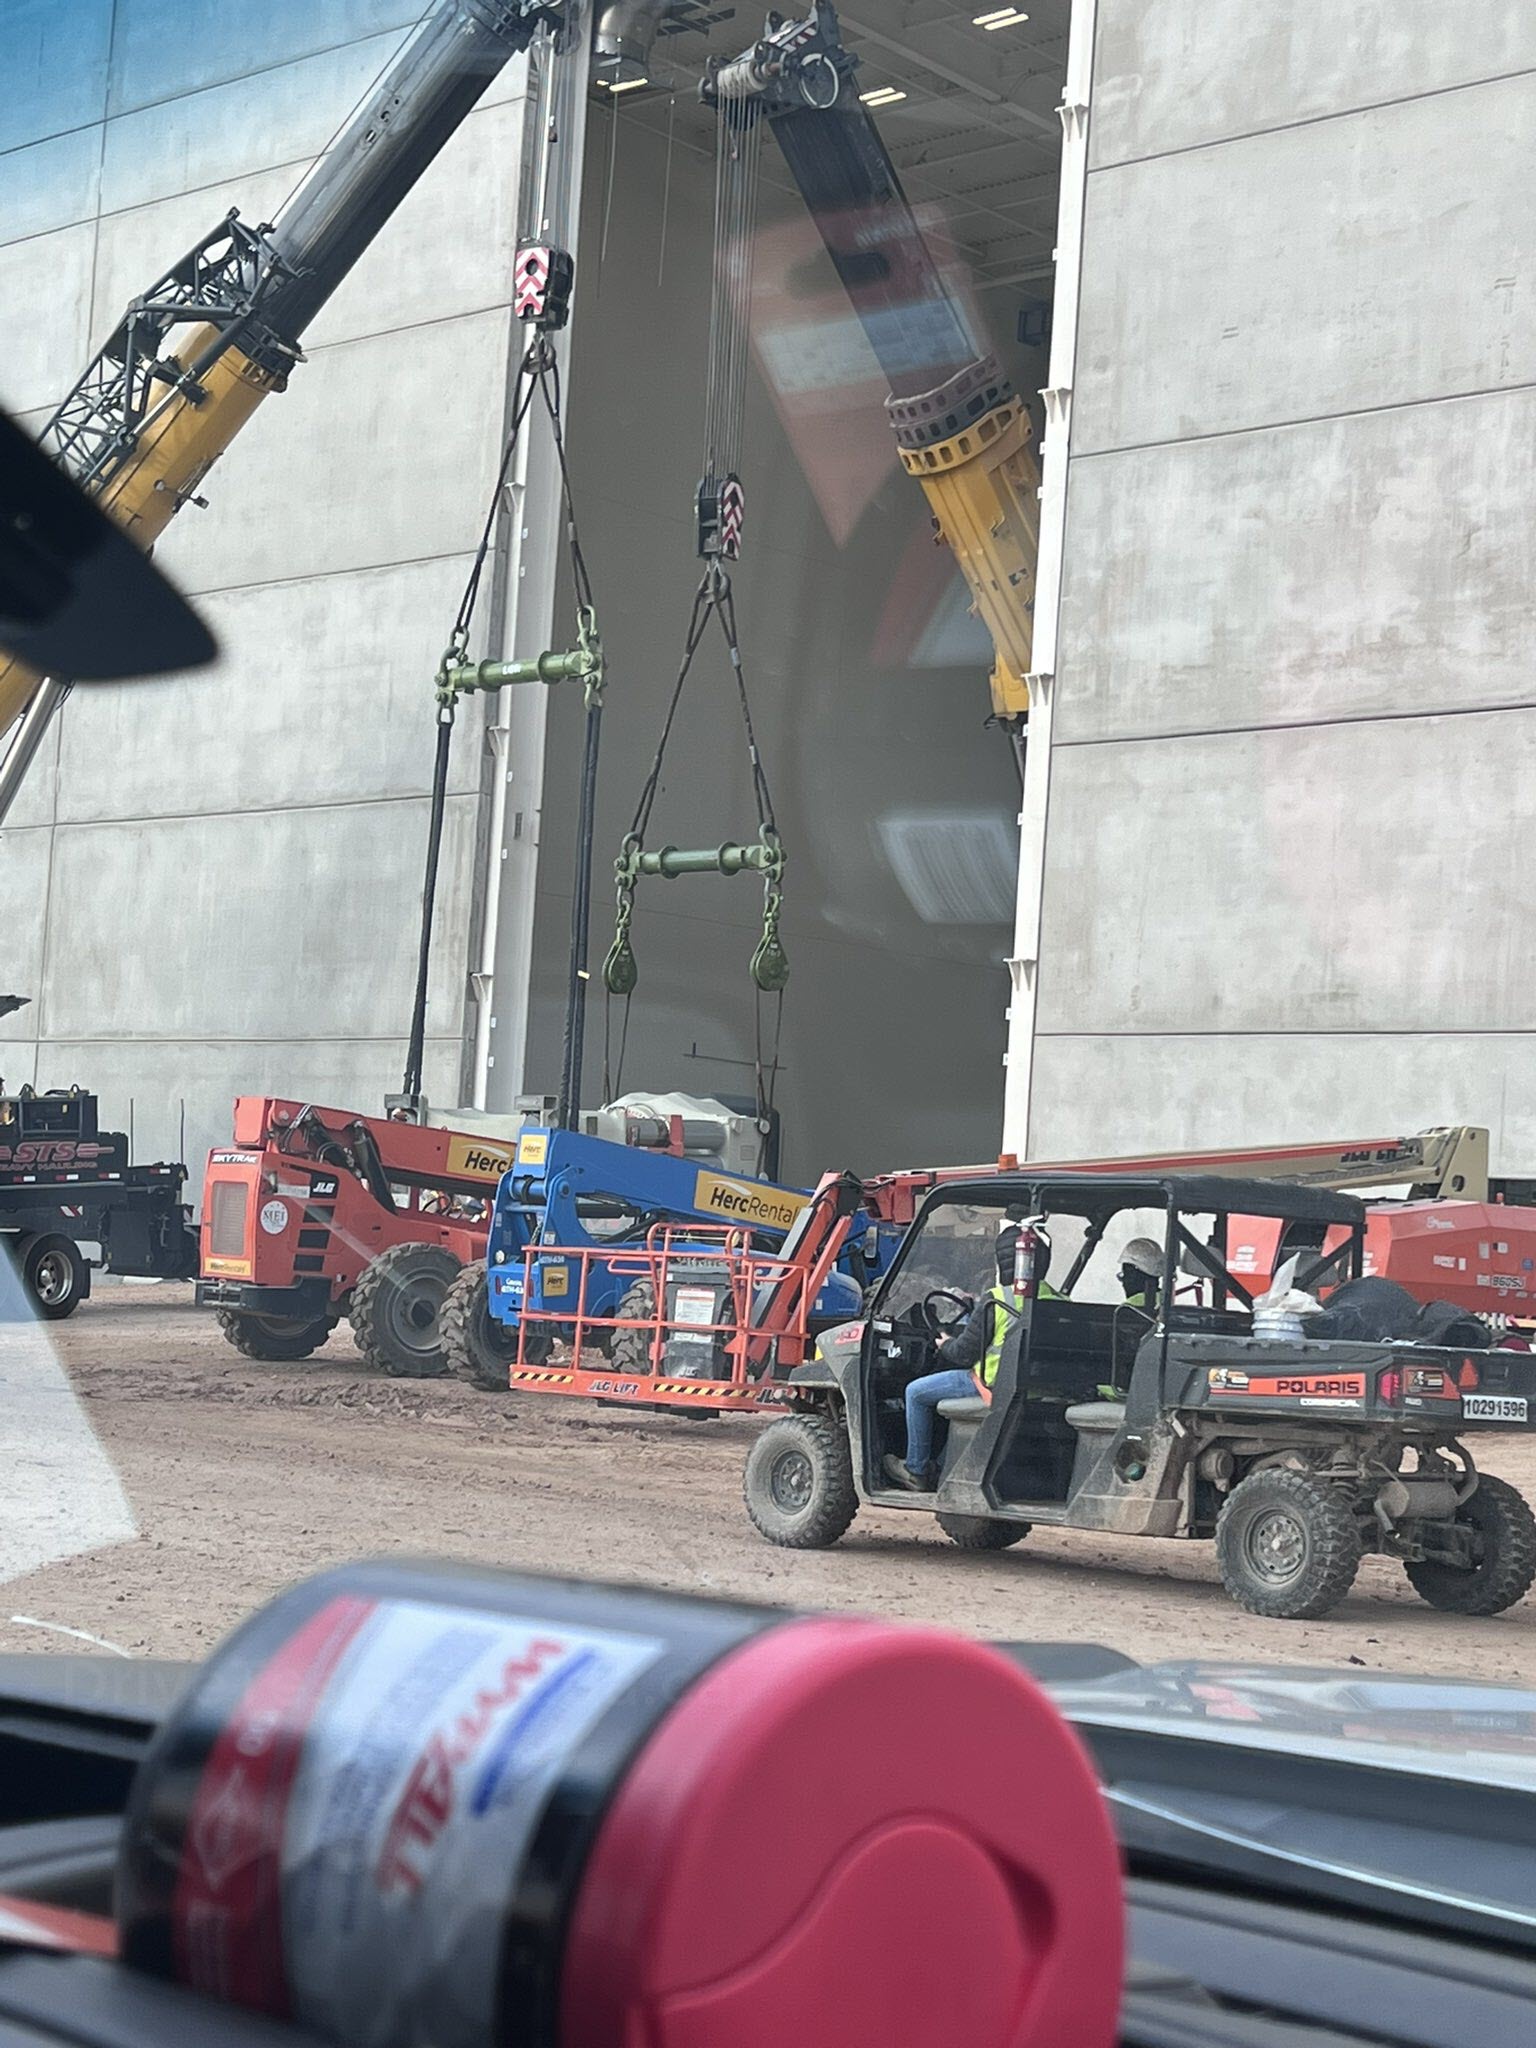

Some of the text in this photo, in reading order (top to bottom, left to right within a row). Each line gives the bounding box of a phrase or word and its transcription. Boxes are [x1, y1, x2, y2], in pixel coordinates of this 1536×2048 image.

[13, 1141, 77, 1162] STS
[313, 1182, 336, 1193] JLG
[710, 1187, 799, 1225] HercRental
[589, 1379, 640, 1396] JLG LIFT
[1277, 1380, 1360, 1394] POLARIS
[1465, 1399, 1526, 1417] 10291596
